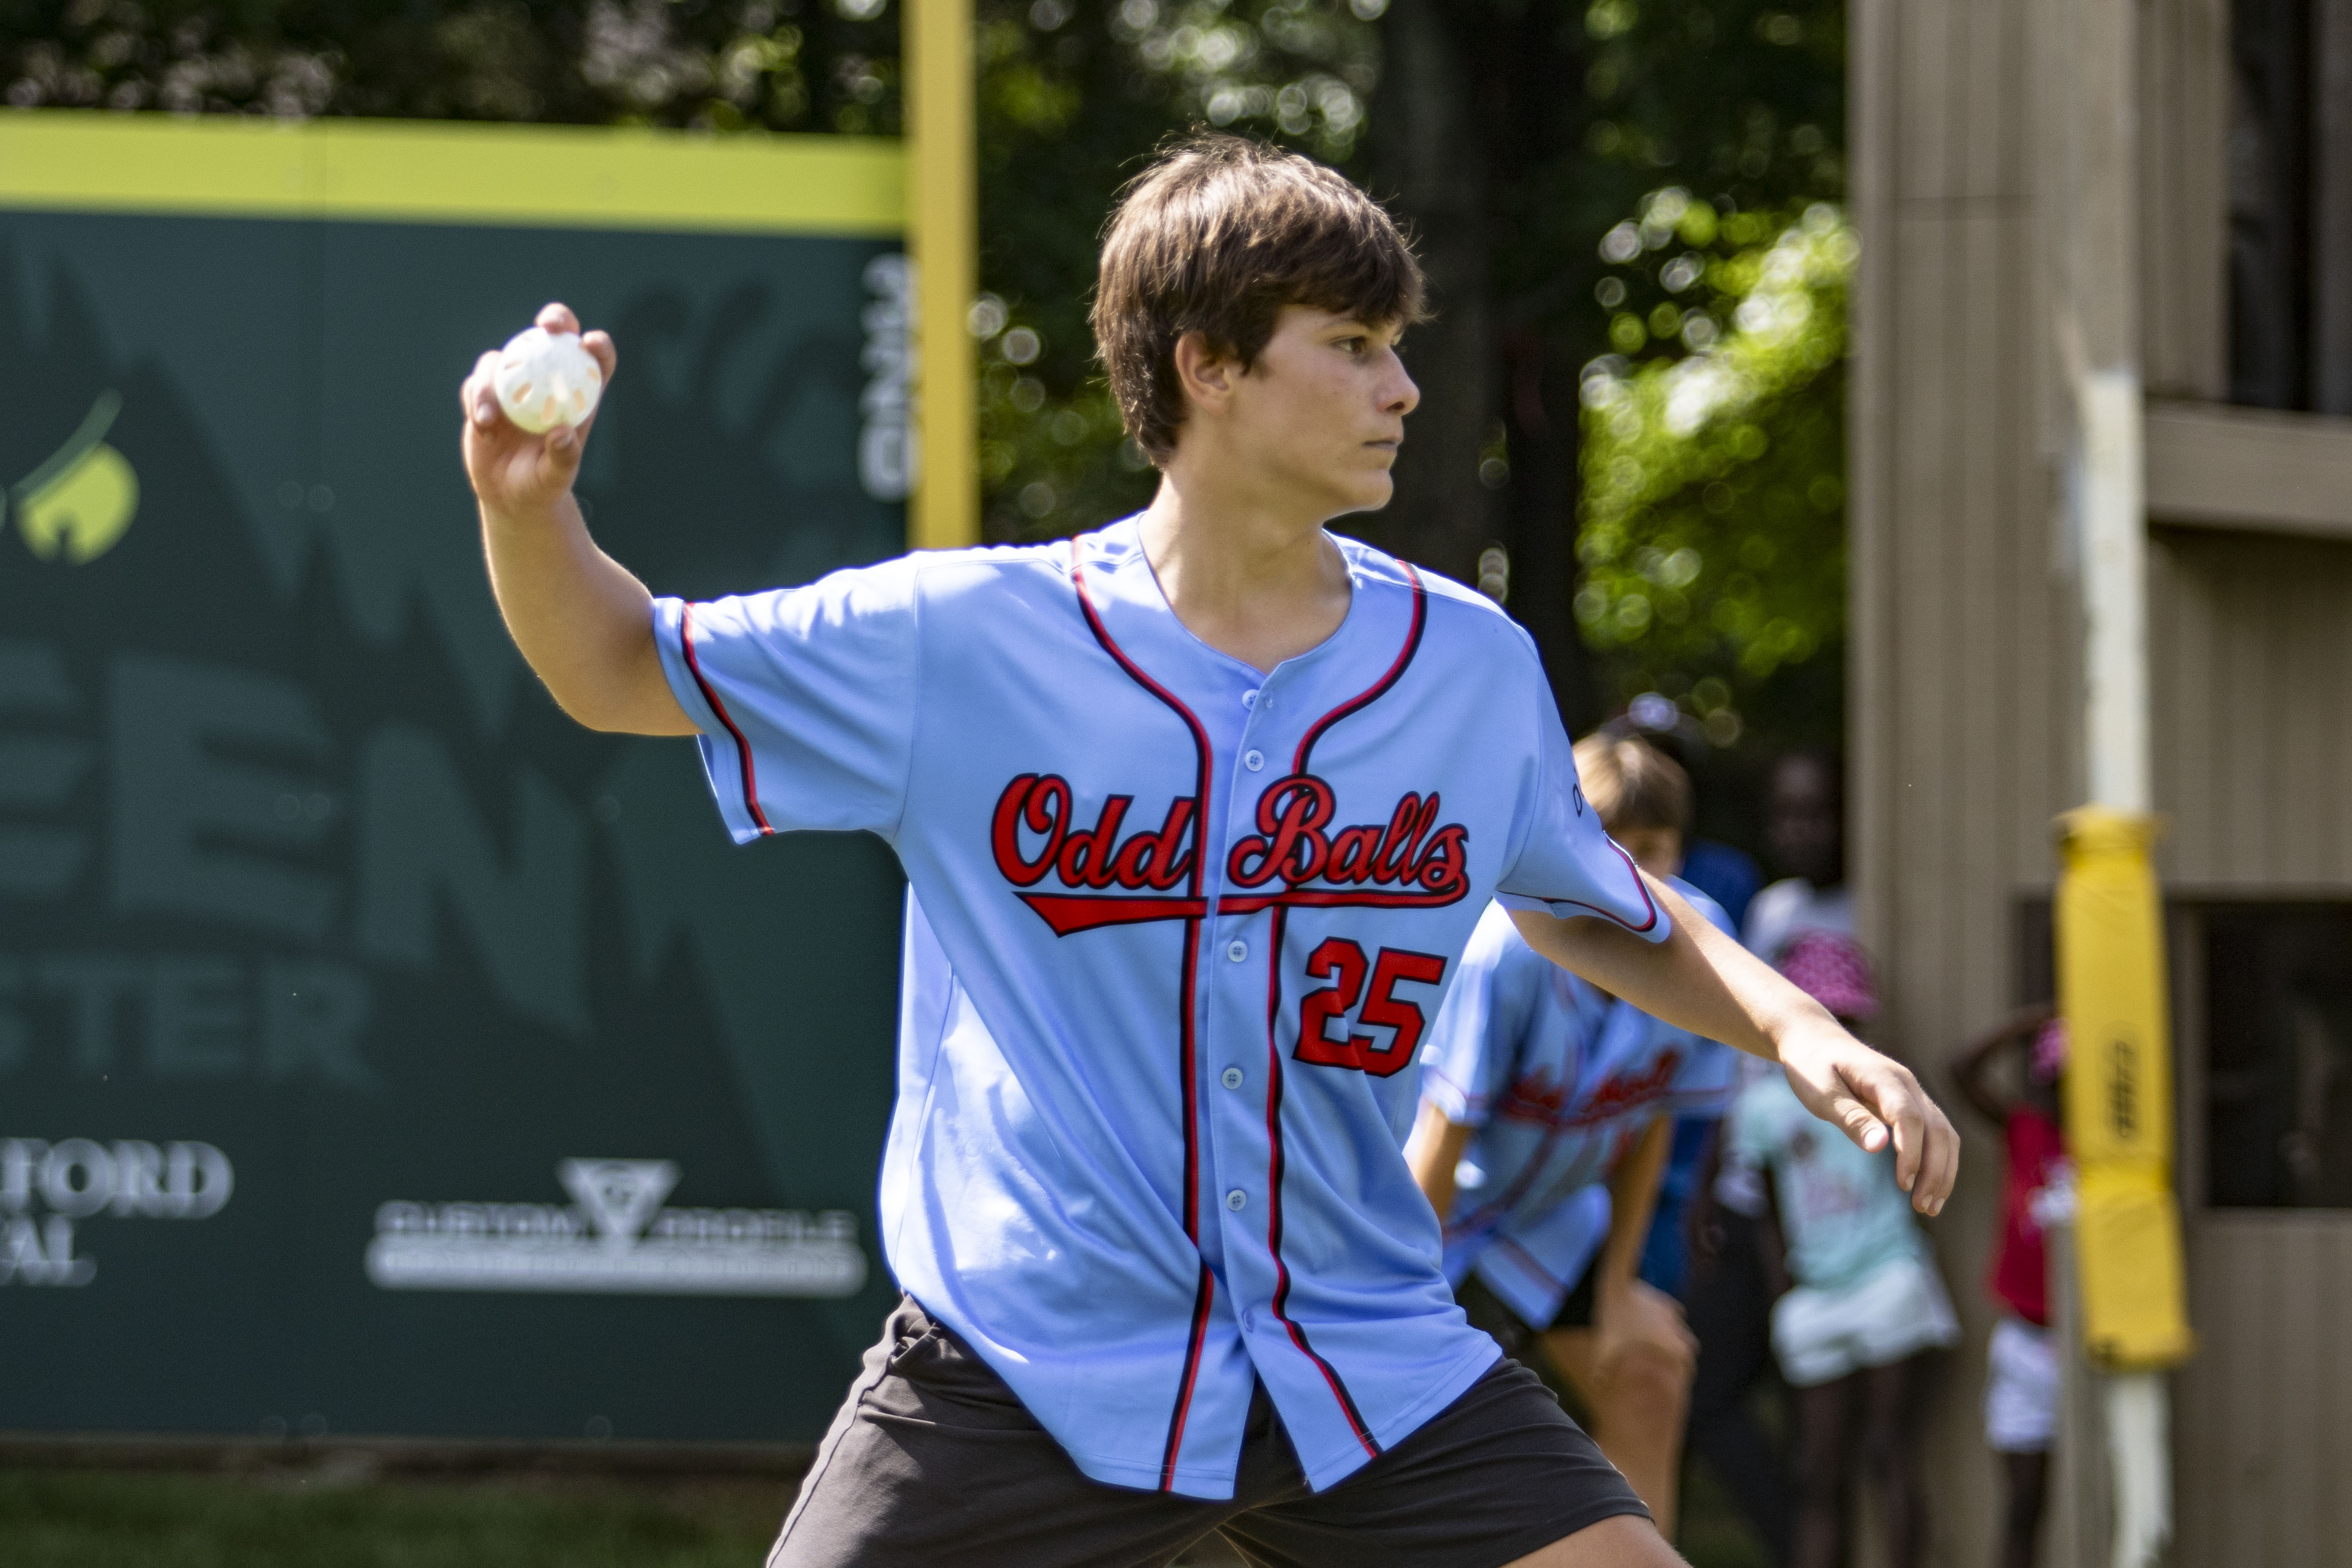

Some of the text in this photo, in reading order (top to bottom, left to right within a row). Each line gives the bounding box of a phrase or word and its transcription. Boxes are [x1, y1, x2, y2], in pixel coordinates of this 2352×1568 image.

[991, 773, 1470, 894] Odd Balls
[1292, 936, 1448, 1078] 25
[0, 1138, 234, 1219] FORD
